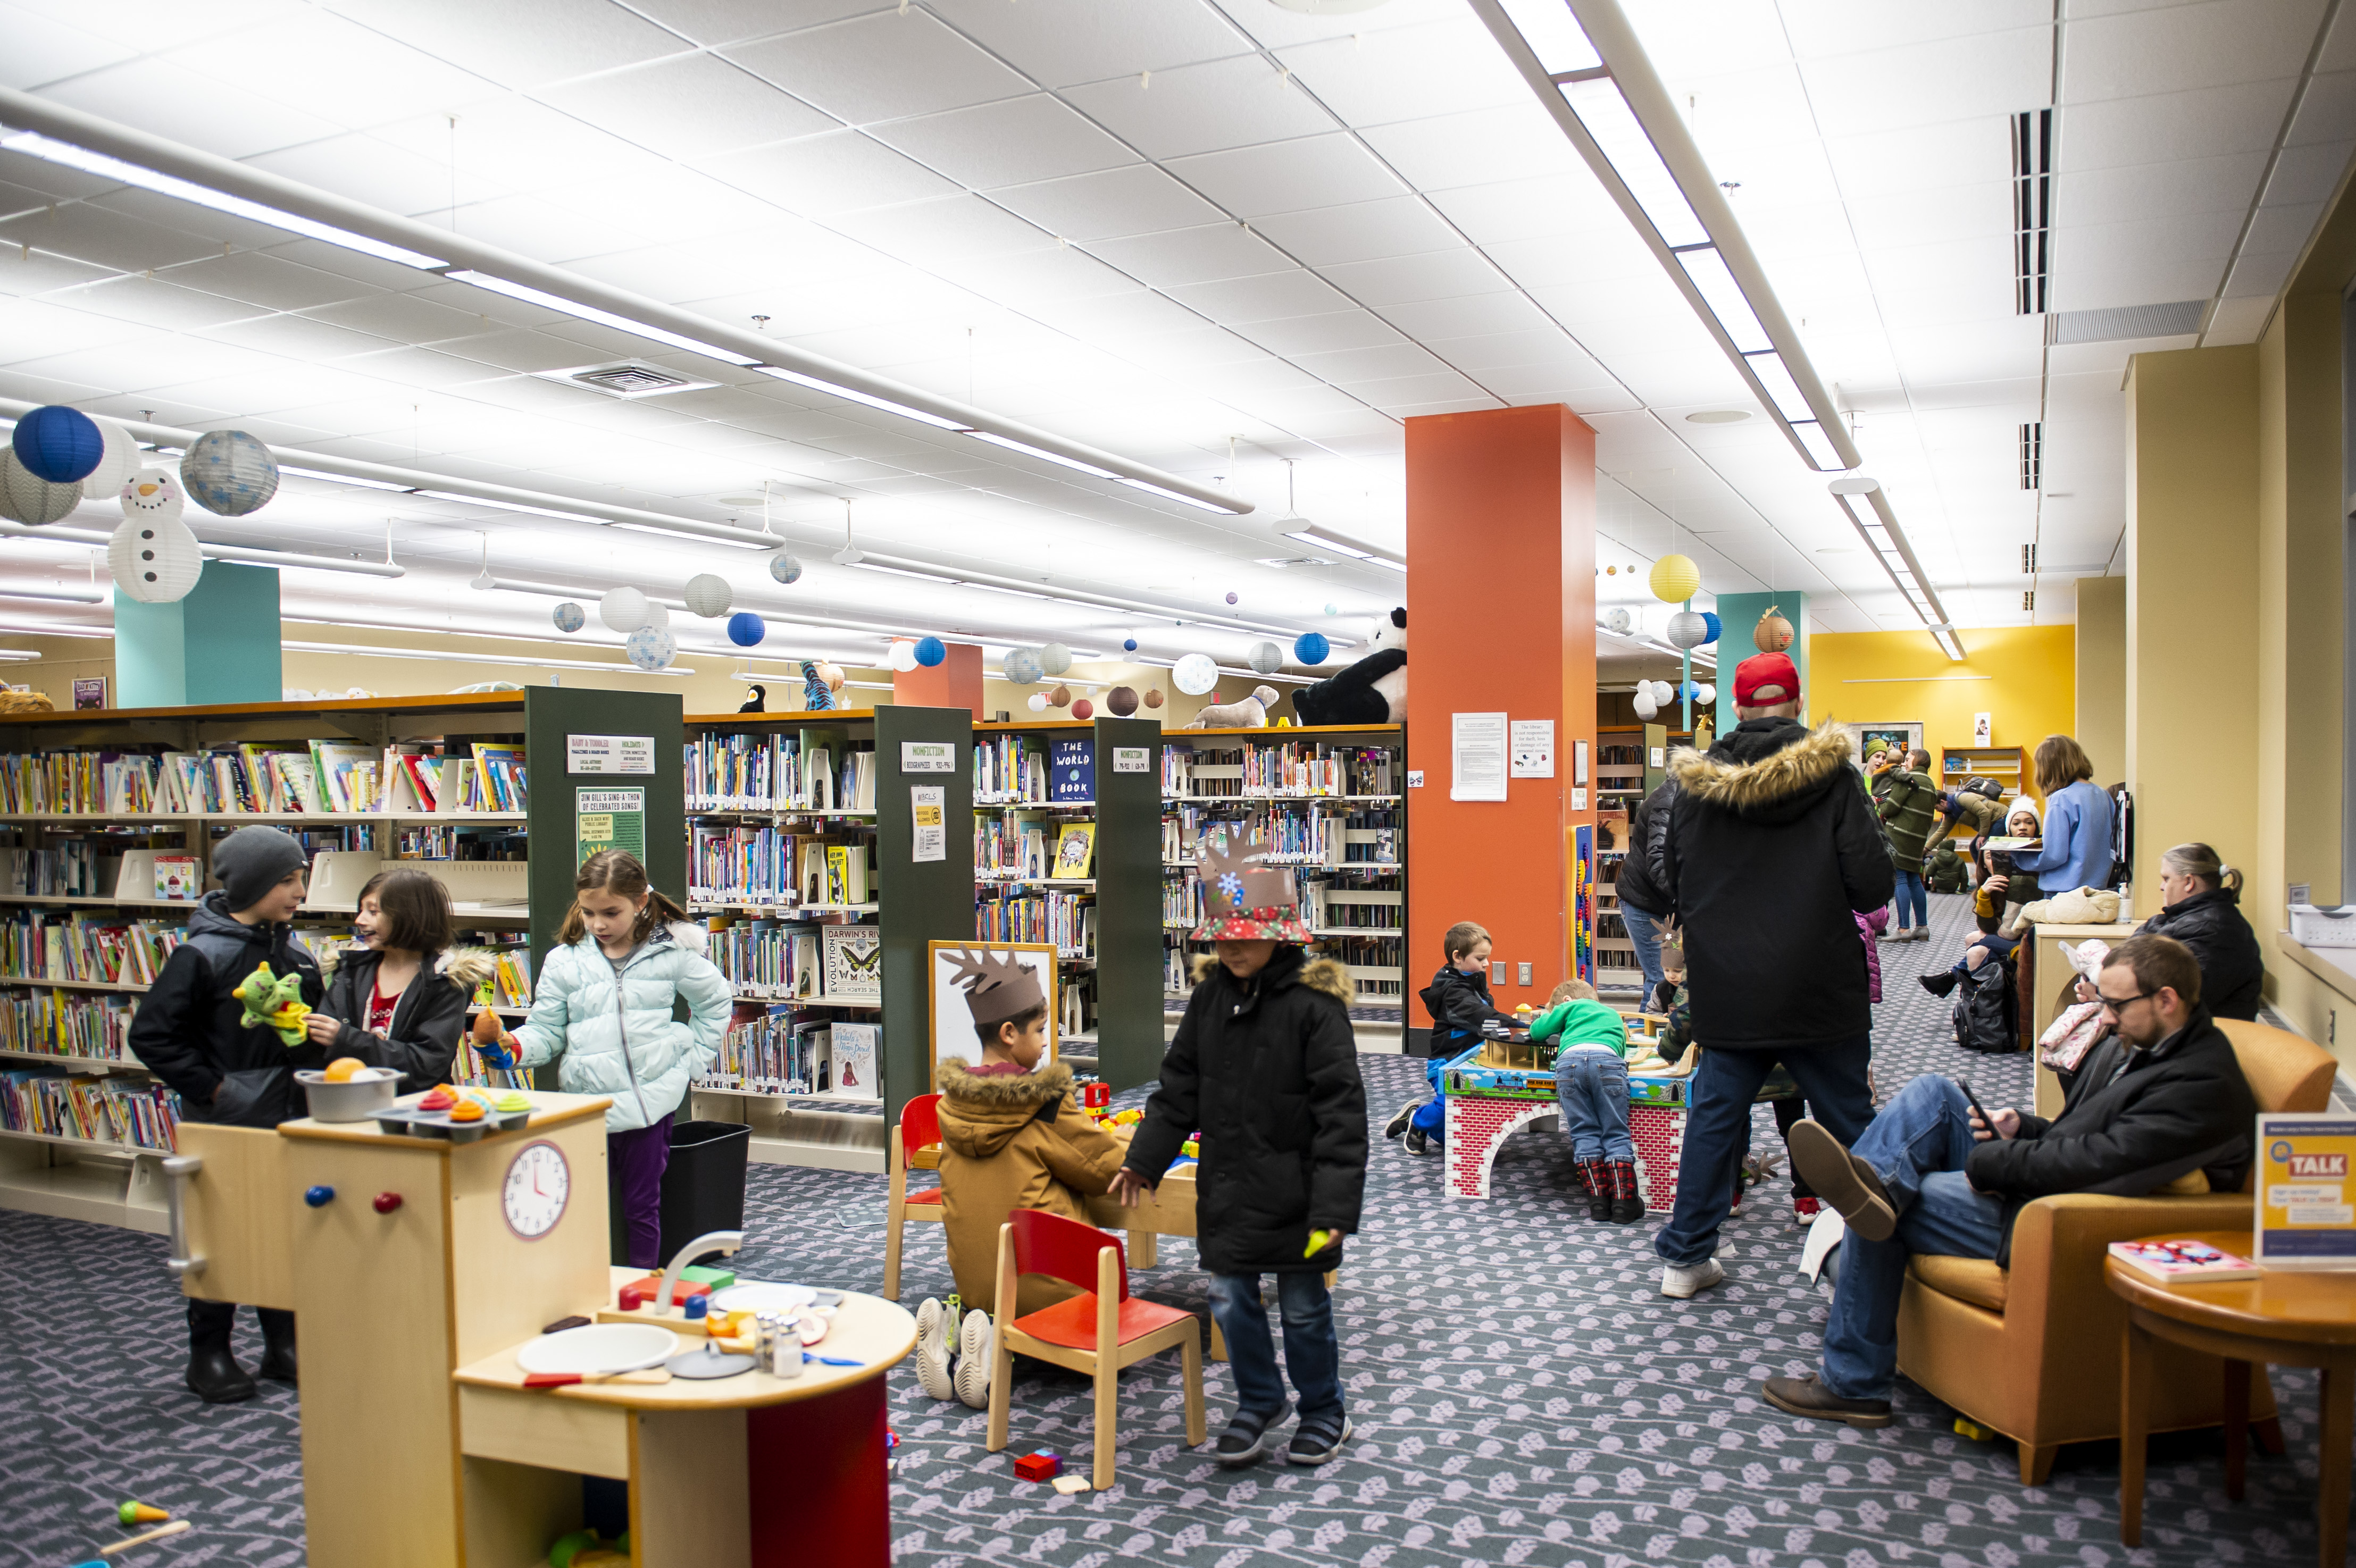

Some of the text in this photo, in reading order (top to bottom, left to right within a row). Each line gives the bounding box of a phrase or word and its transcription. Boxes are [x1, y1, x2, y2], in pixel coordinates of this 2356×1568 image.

[589, 739, 609, 748] TODDLER
[1063, 742, 1082, 752] THE
[912, 746, 945, 756] NONFICTION
[1121, 750, 1142, 759] NONFICTION
[1056, 754, 1090, 766] WORLD
[1060, 783, 1087, 793] BOOK
[590, 802, 620, 811] CELEBRATED
[829, 939, 837, 992] EVOLUTION
[532, 1152, 540, 1163] 12
[546, 1153, 549, 1163] 1
[522, 1160, 527, 1170] 11
[554, 1162, 558, 1173] 2
[2292, 1156, 2344, 1173] TALK
[513, 1174, 521, 1185] 10
[558, 1177, 562, 1188] 3
[508, 1193, 514, 1202] 9
[554, 1195, 559, 1205] 4
[513, 1209, 519, 1220] 8
[547, 1209, 552, 1220] 5
[524, 1217, 529, 1228] 7
[535, 1219, 540, 1229] 6
